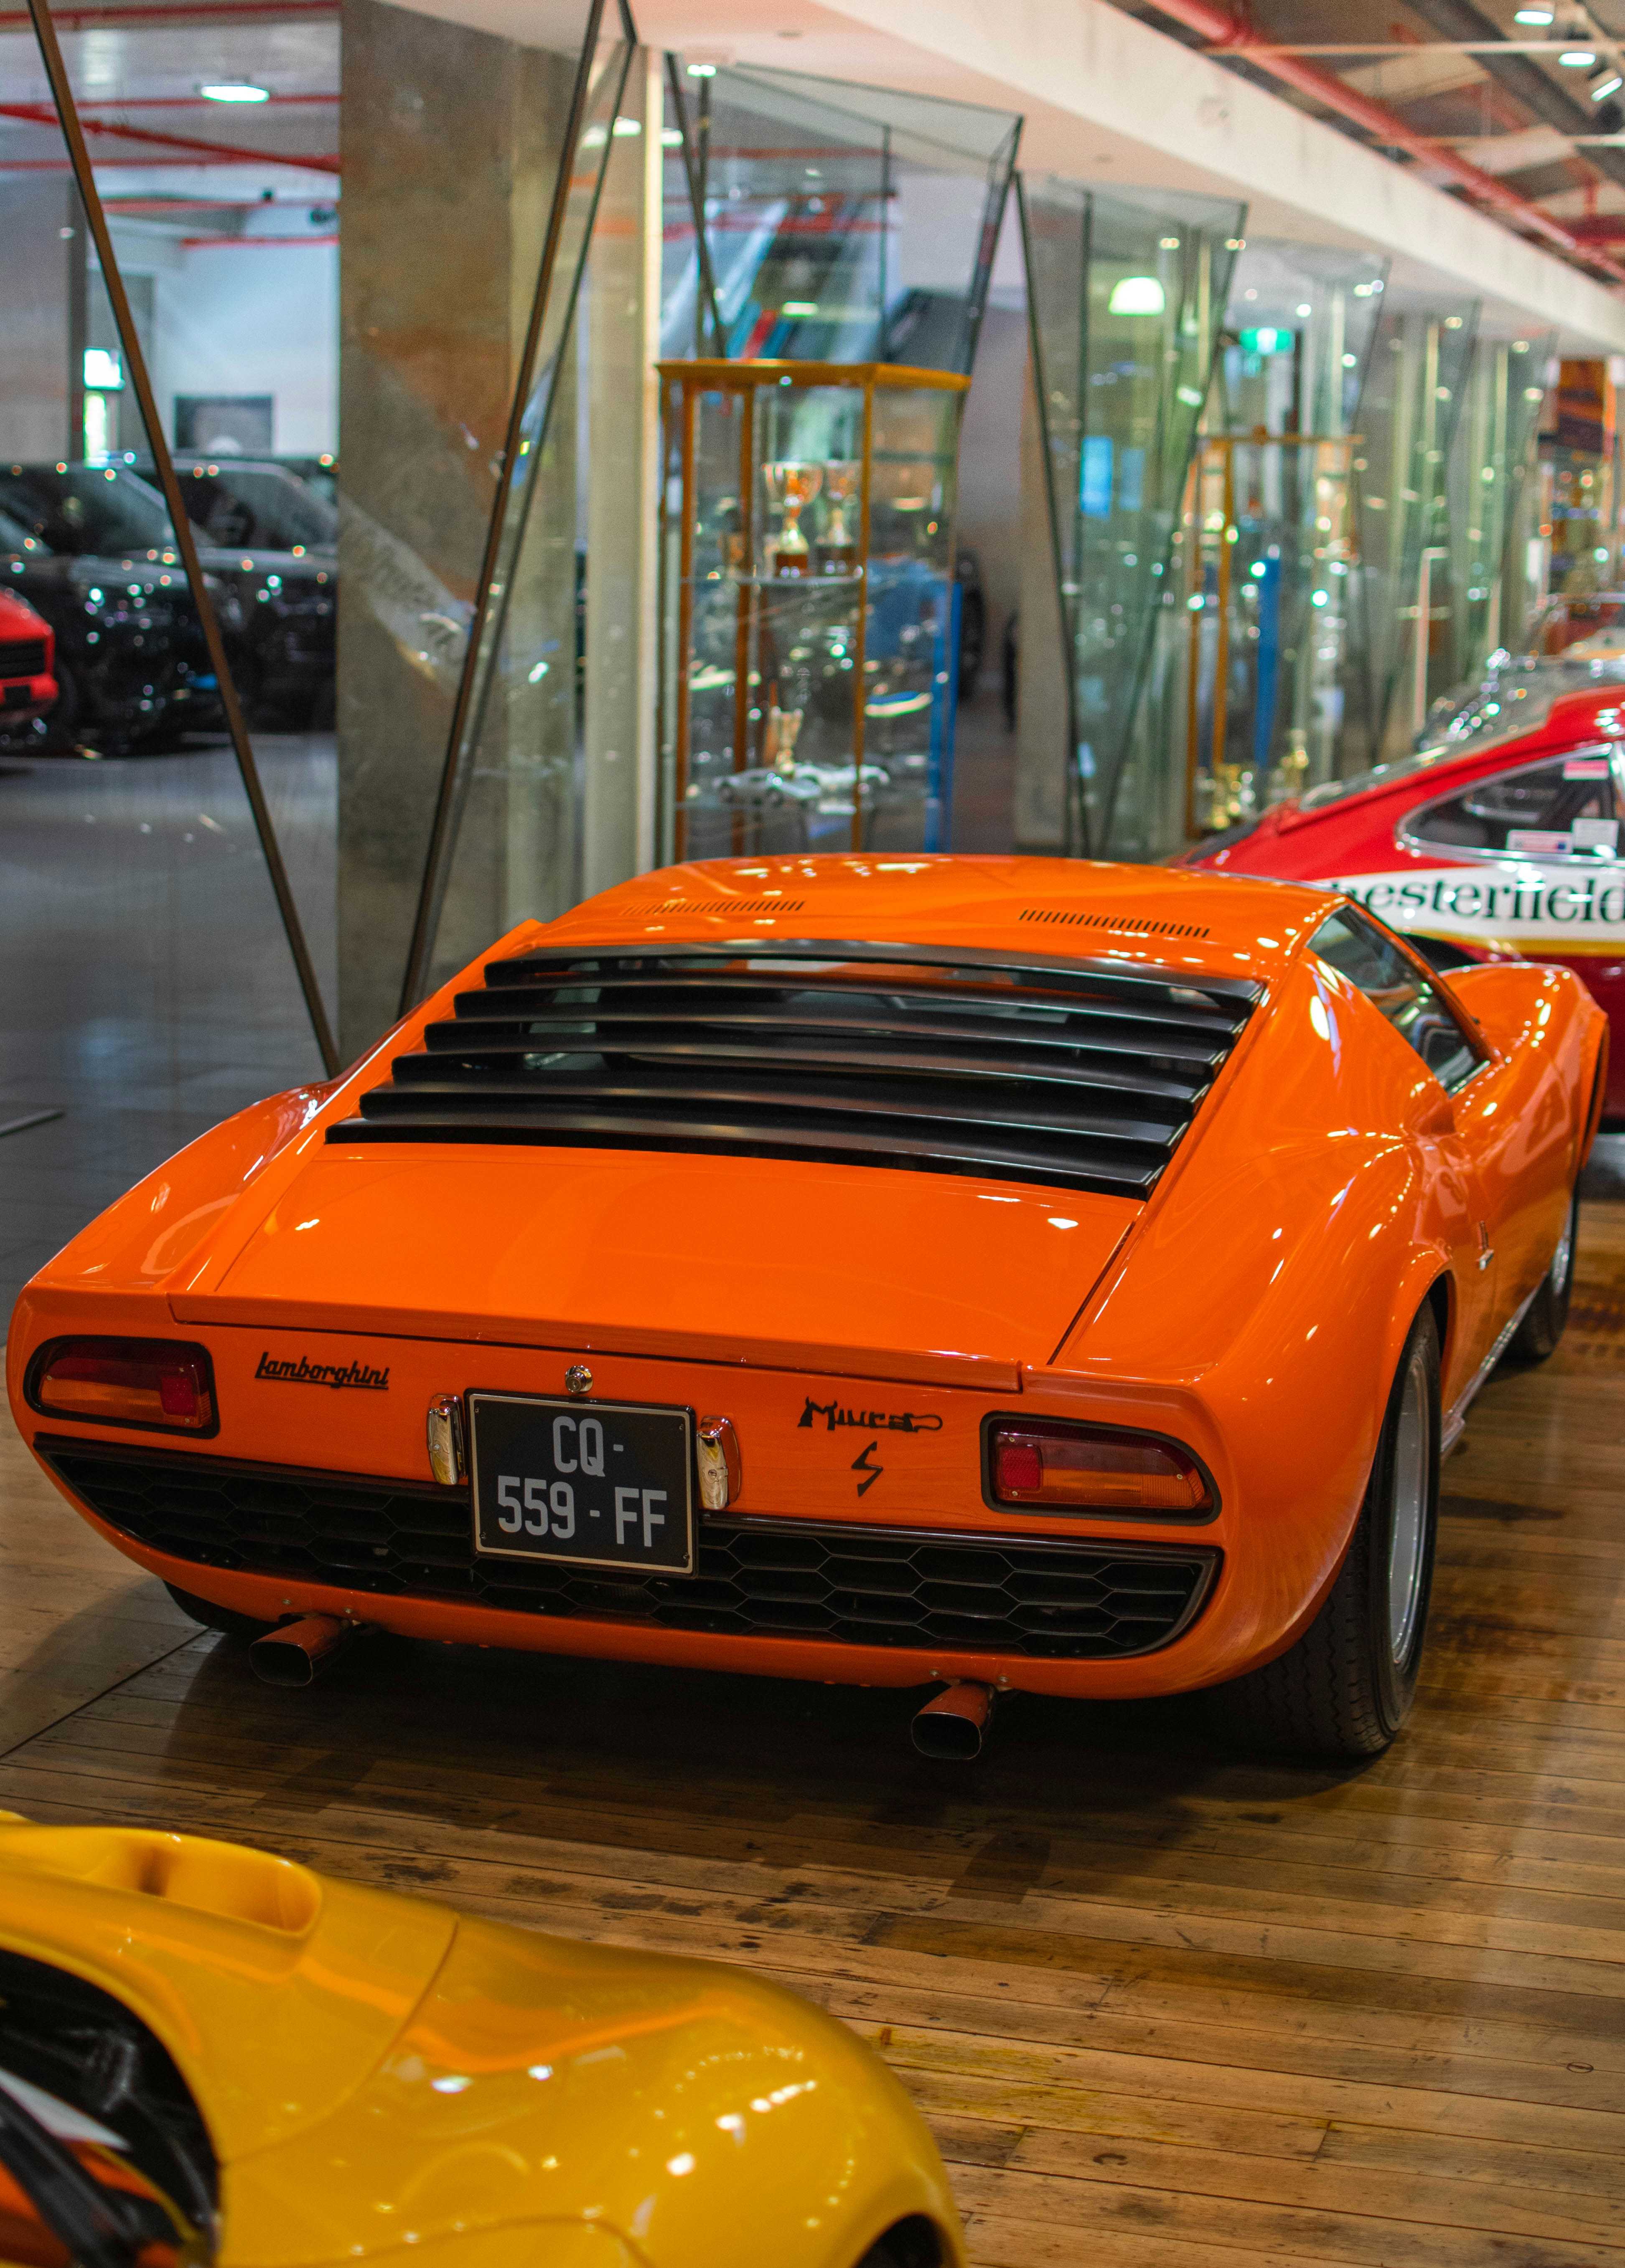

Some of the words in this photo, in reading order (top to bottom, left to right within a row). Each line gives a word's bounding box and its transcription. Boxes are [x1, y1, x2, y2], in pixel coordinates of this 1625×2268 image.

[254, 1351, 390, 1390] Lamborghini
[797, 1396, 943, 1433] Miura
[851, 1441, 883, 1497] S
